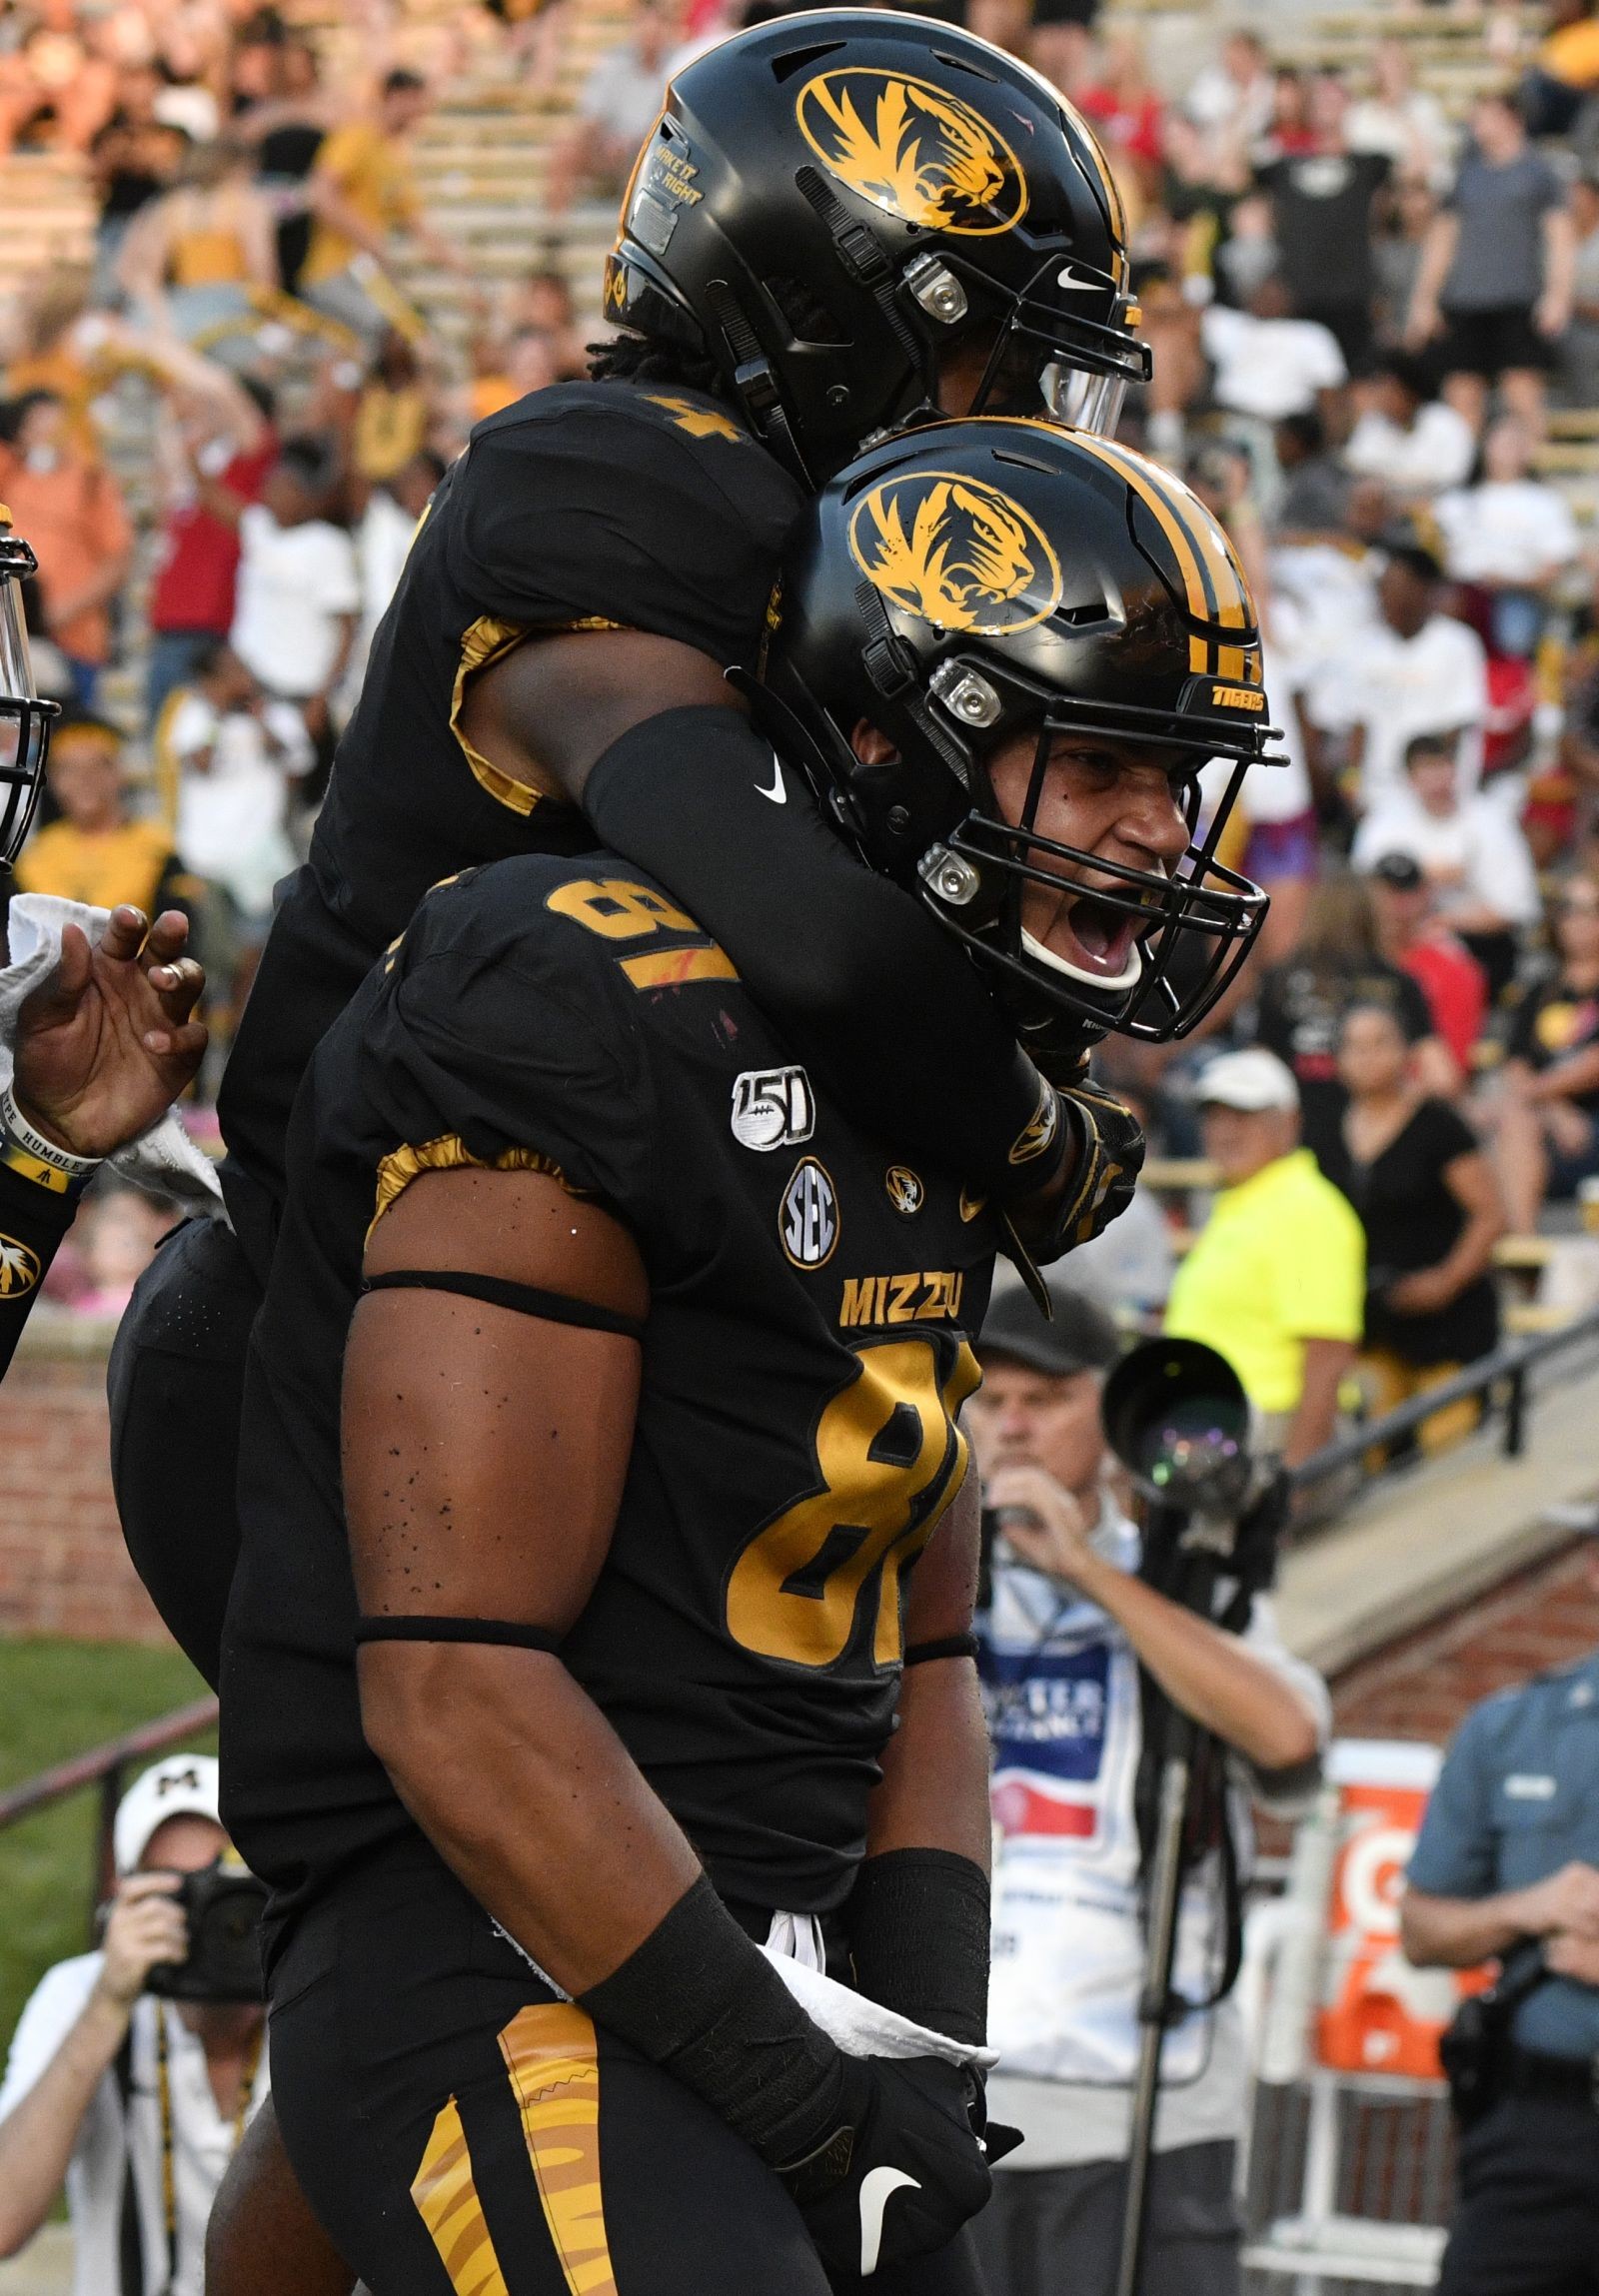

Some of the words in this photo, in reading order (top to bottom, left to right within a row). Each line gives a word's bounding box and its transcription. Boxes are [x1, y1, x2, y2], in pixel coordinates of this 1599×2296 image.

[655, 145, 685, 173] MAKE
[680, 164, 698, 180] IT
[662, 172, 703, 205] RIGHT
[1212, 685, 1264, 712] TIGERS
[22, 1131, 83, 1171] HUMBLE
[785, 1164, 835, 1263] SEC
